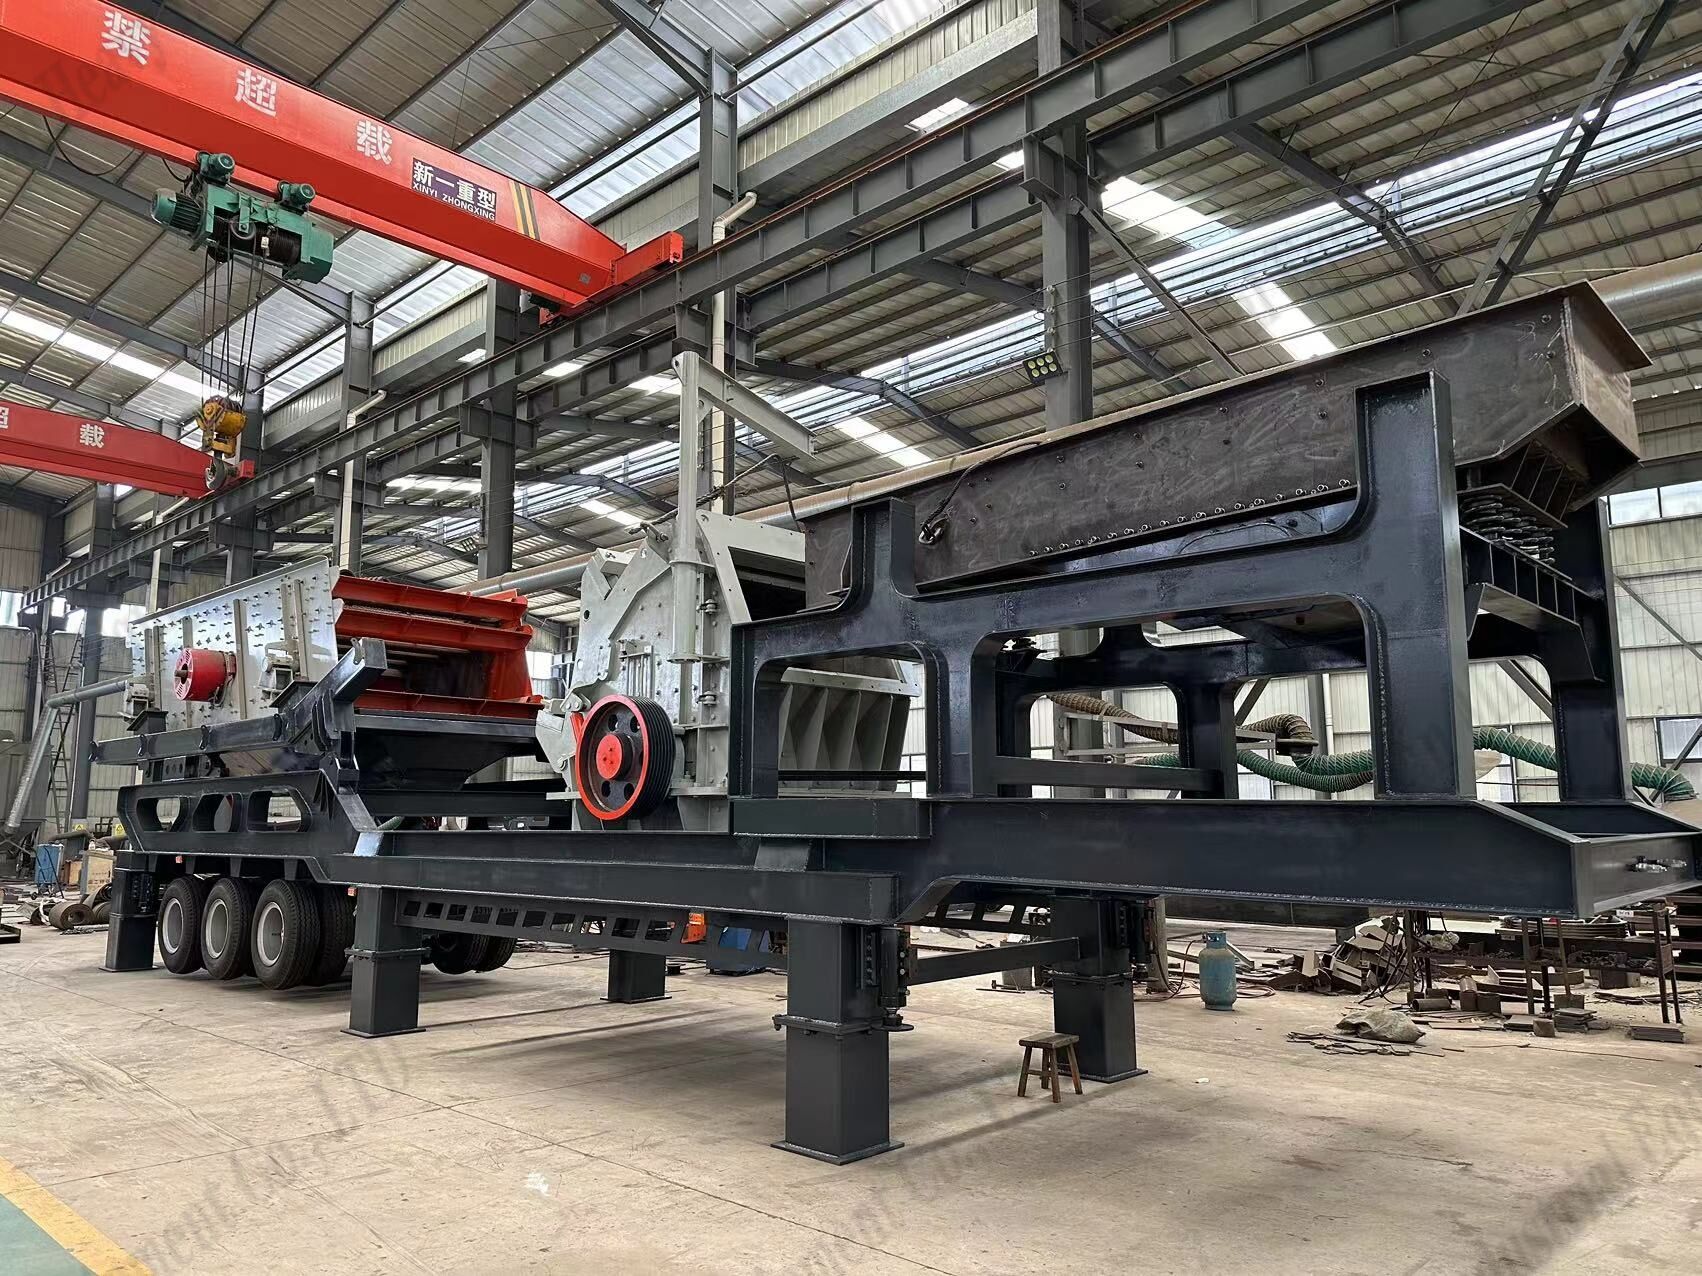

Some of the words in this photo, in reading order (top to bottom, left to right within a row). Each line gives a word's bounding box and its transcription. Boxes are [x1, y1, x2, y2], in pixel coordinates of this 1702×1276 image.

[412, 182, 438, 198] XINYI
[442, 193, 495, 221] ZHONGXING
[413, 161, 496, 212] 新一重型
